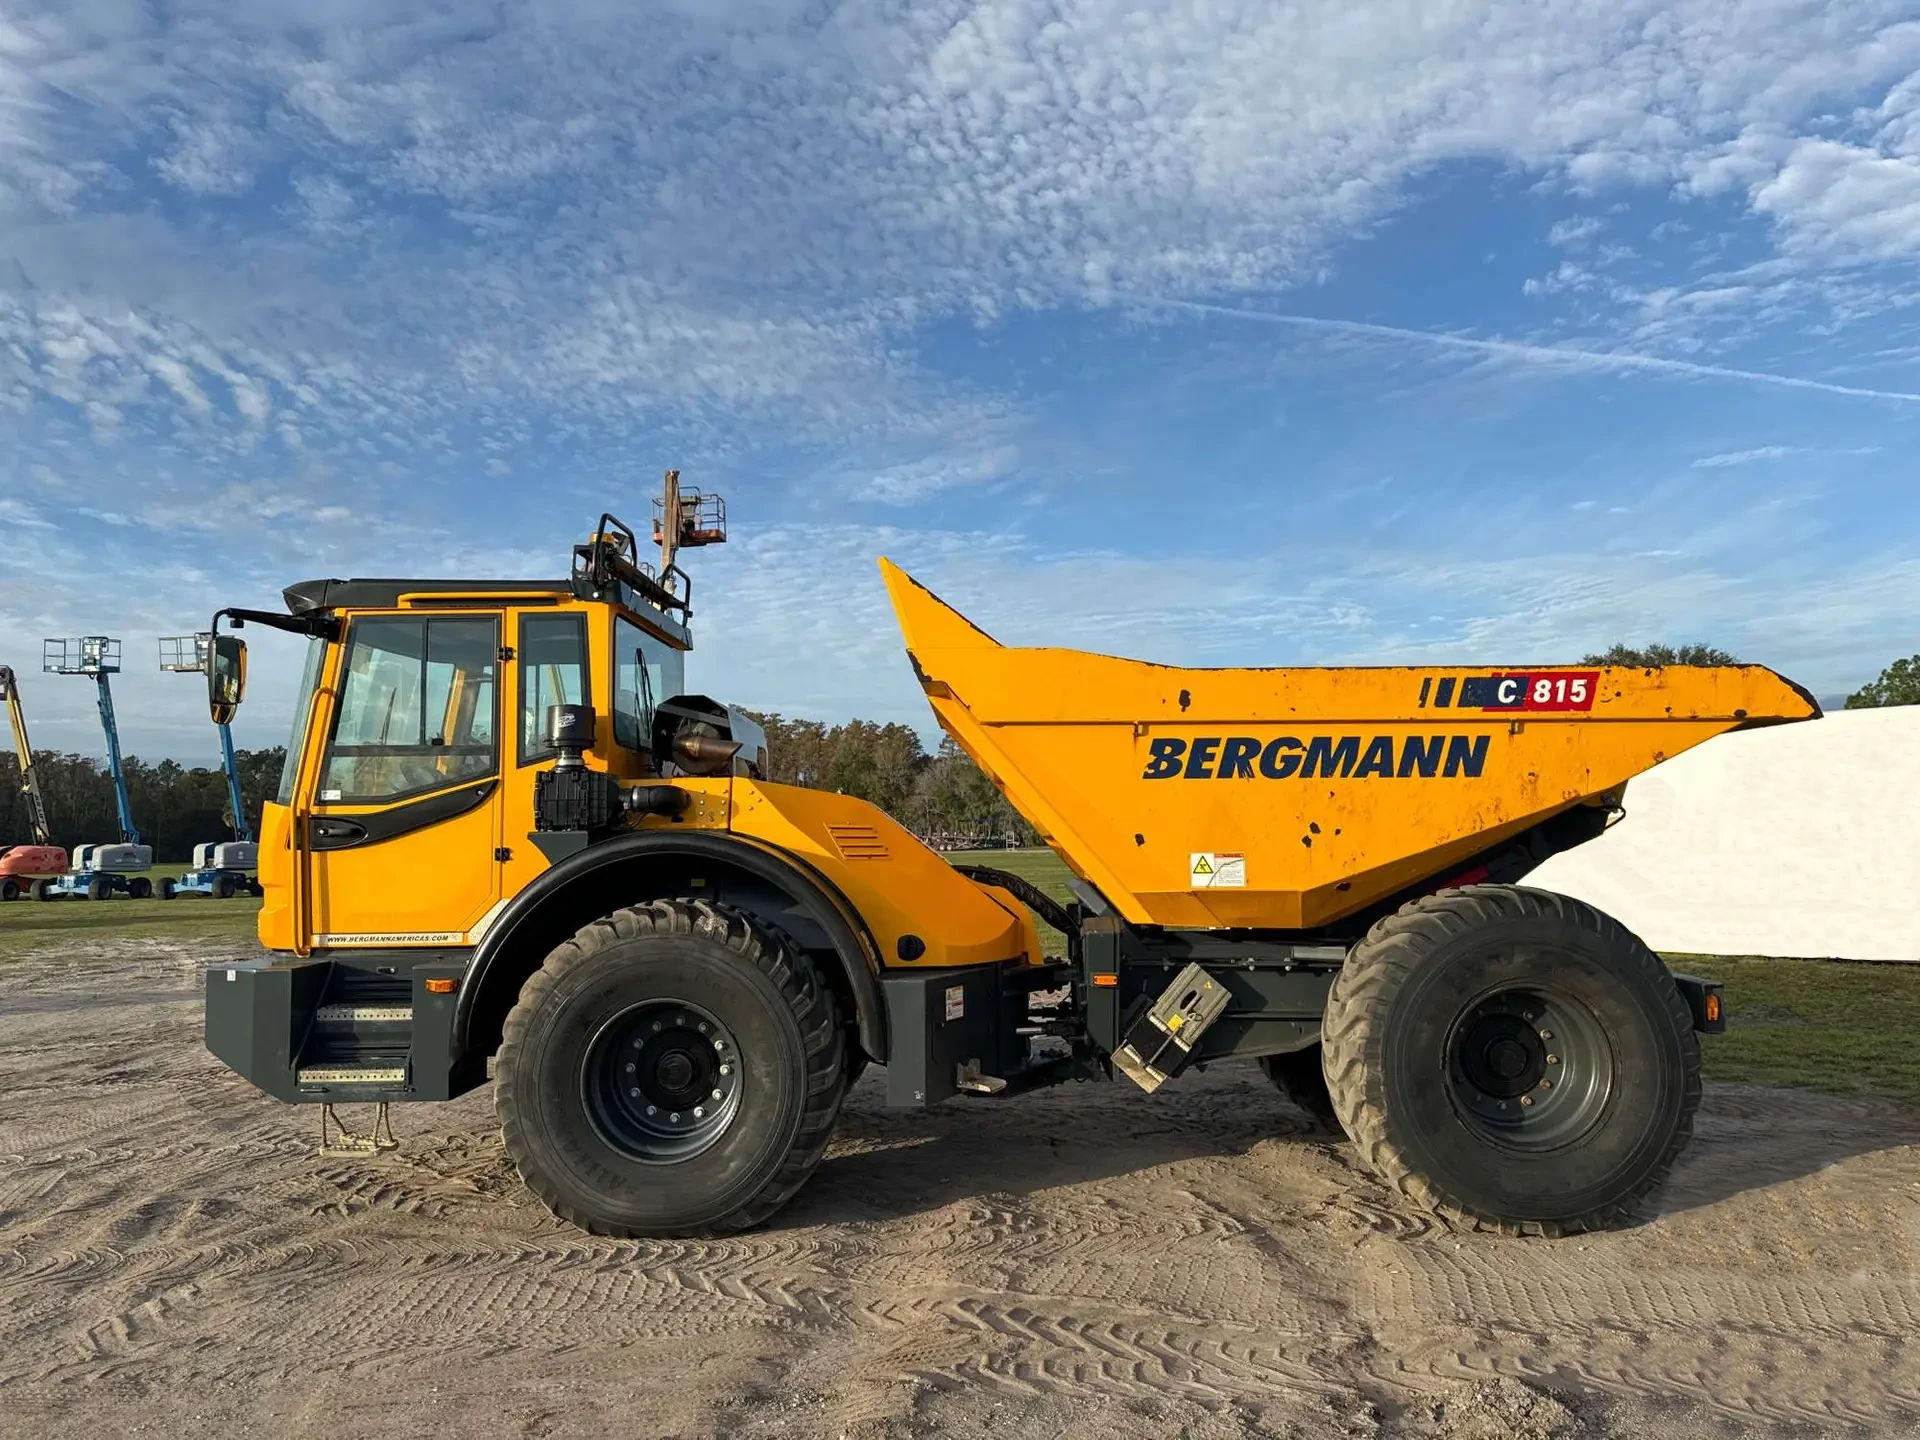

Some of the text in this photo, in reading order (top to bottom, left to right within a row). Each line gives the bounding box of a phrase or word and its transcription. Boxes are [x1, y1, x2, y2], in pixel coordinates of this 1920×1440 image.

[1498, 679, 1587, 703] C 815
[1143, 736, 1491, 779] BERGMANN
